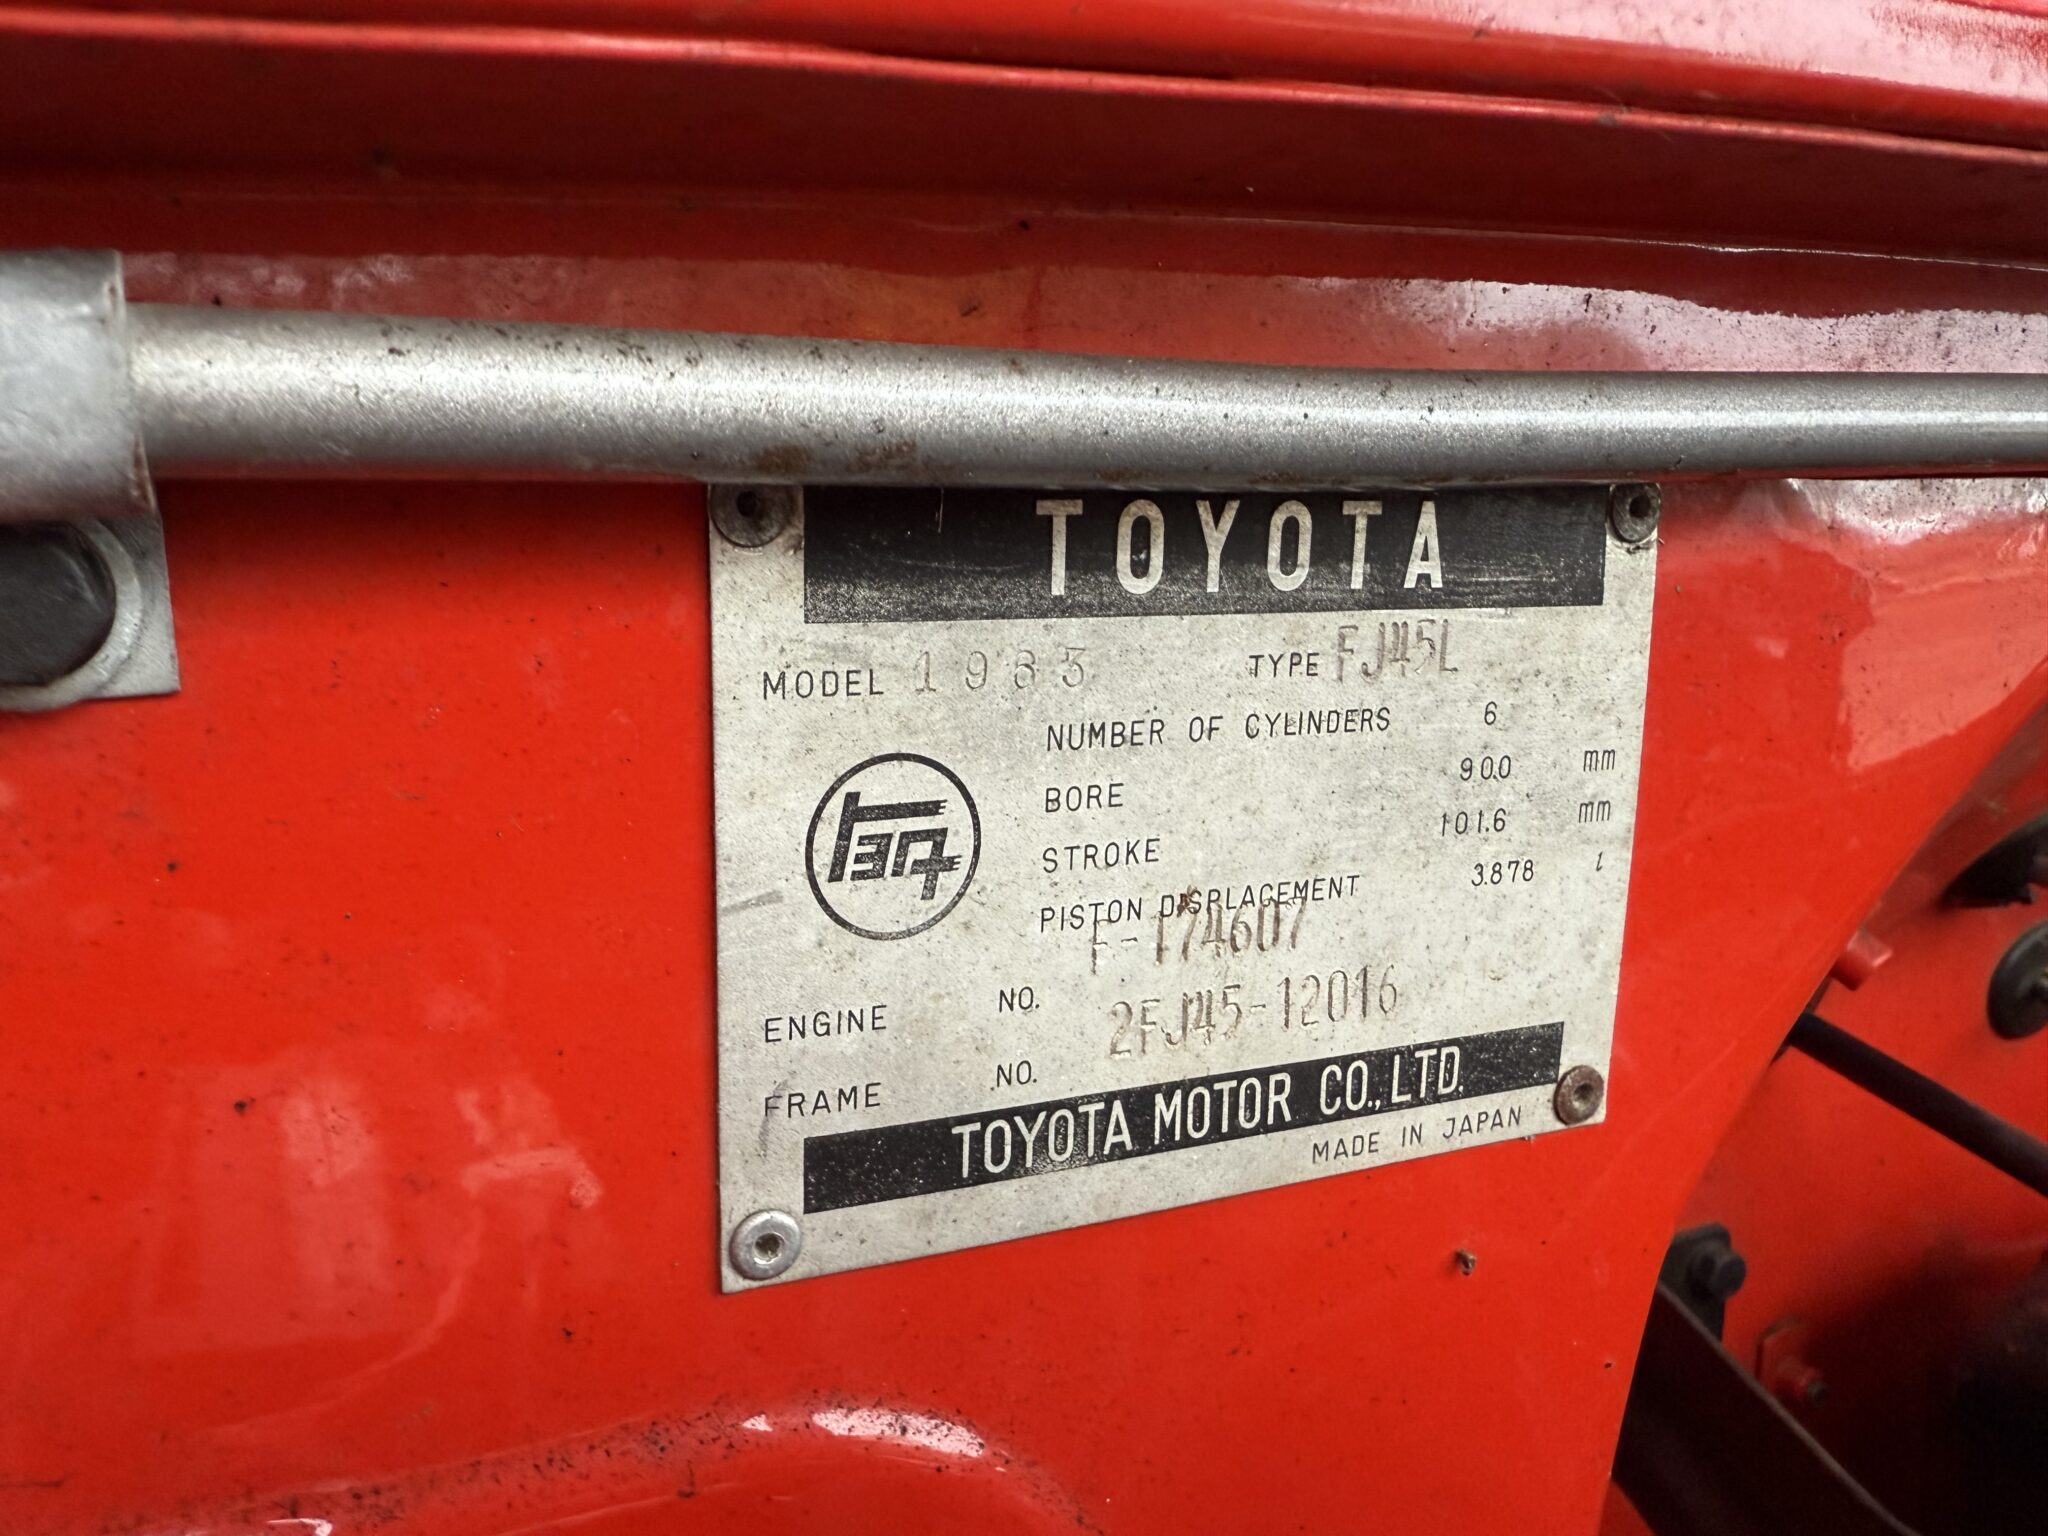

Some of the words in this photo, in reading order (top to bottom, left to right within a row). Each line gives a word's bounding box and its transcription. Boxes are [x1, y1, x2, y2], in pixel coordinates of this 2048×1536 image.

[1036, 499, 1443, 596] TOYOTA
[1249, 652, 1320, 677] TYPE
[1336, 618, 1458, 683] FJ45L
[763, 670, 884, 699] MODEL
[1047, 719, 1165, 751] NUMBER
[1188, 716, 1223, 743] OF
[1245, 707, 1391, 739] CYLINDERS
[1484, 701, 1497, 725] 6
[1045, 783, 1124, 813] BORE
[1583, 749, 1616, 772] mm
[1042, 839, 1160, 873] STROKE
[1441, 808, 1506, 836] 101.6
[1578, 800, 1611, 823] mm
[1041, 897, 1142, 932] PISTON
[1471, 859, 1534, 886] 3.878
[764, 1082, 882, 1118] FRAME
[995, 1060, 1037, 1087] NO.
[1110, 964, 1398, 1057] 2FJ45-12016
[765, 1005, 887, 1043] ENGINE
[999, 986, 1040, 1012] NO.
[952, 1101, 1133, 1178] TOYOTA
[1153, 1072, 1293, 1146] MOTOR
[1312, 1132, 1380, 1164] MADE
[1401, 1123, 1422, 1147] IN
[1442, 1106, 1522, 1140] JAPAN
